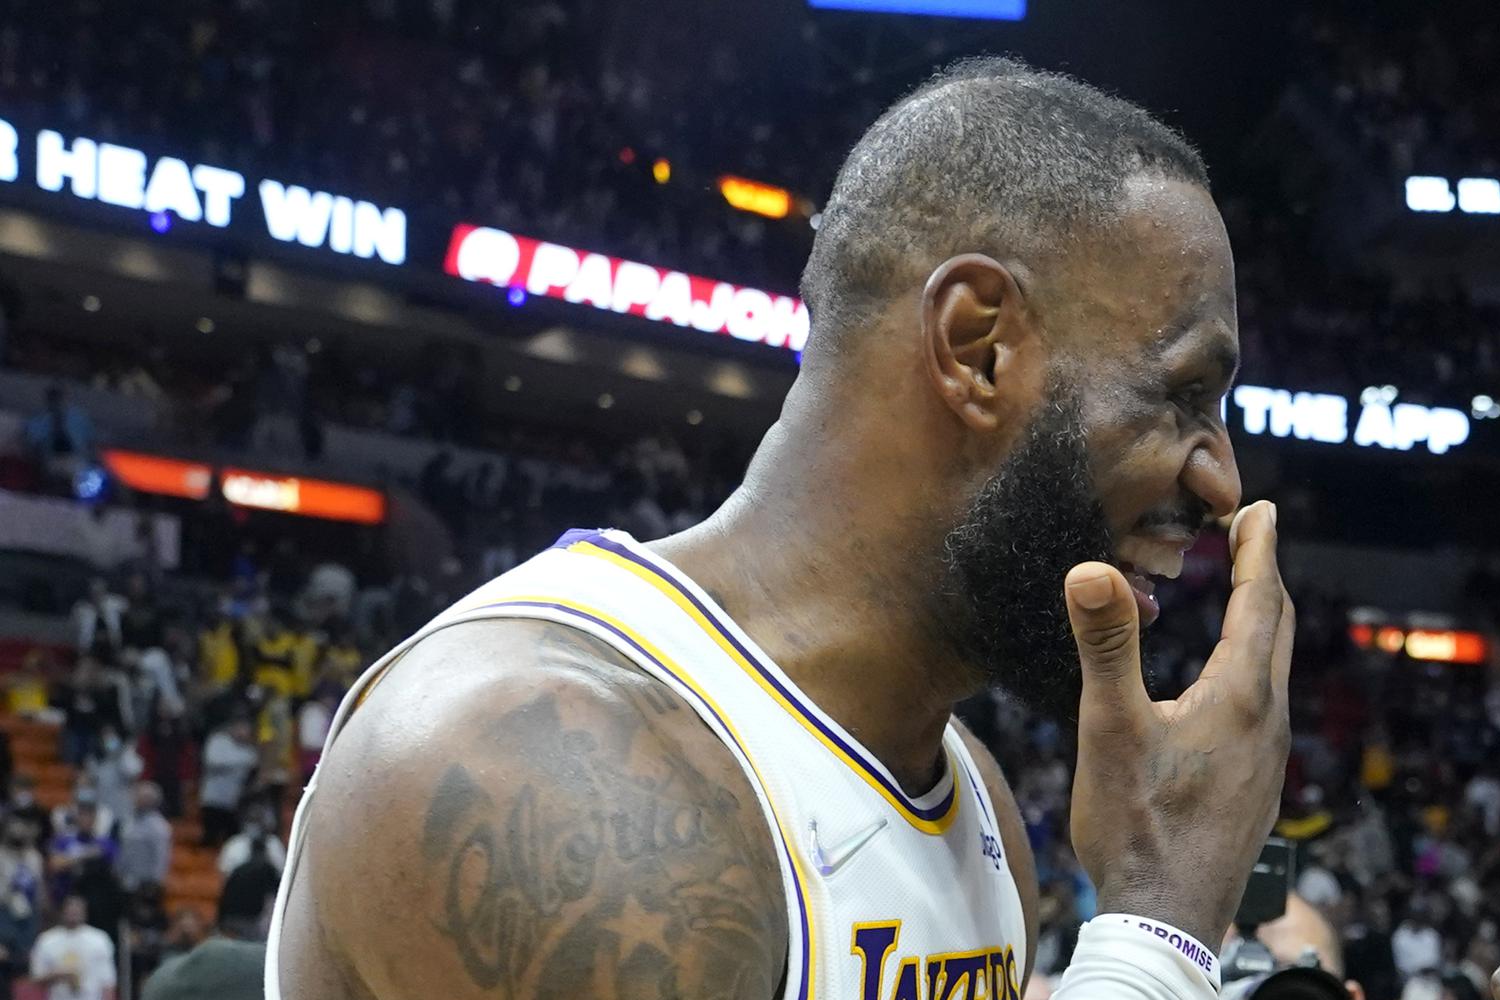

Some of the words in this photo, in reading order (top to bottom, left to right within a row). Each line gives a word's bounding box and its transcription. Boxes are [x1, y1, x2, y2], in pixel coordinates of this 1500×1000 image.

[36, 129, 246, 228] HEAT
[258, 178, 407, 265] WIN
[1234, 384, 1348, 444] THE
